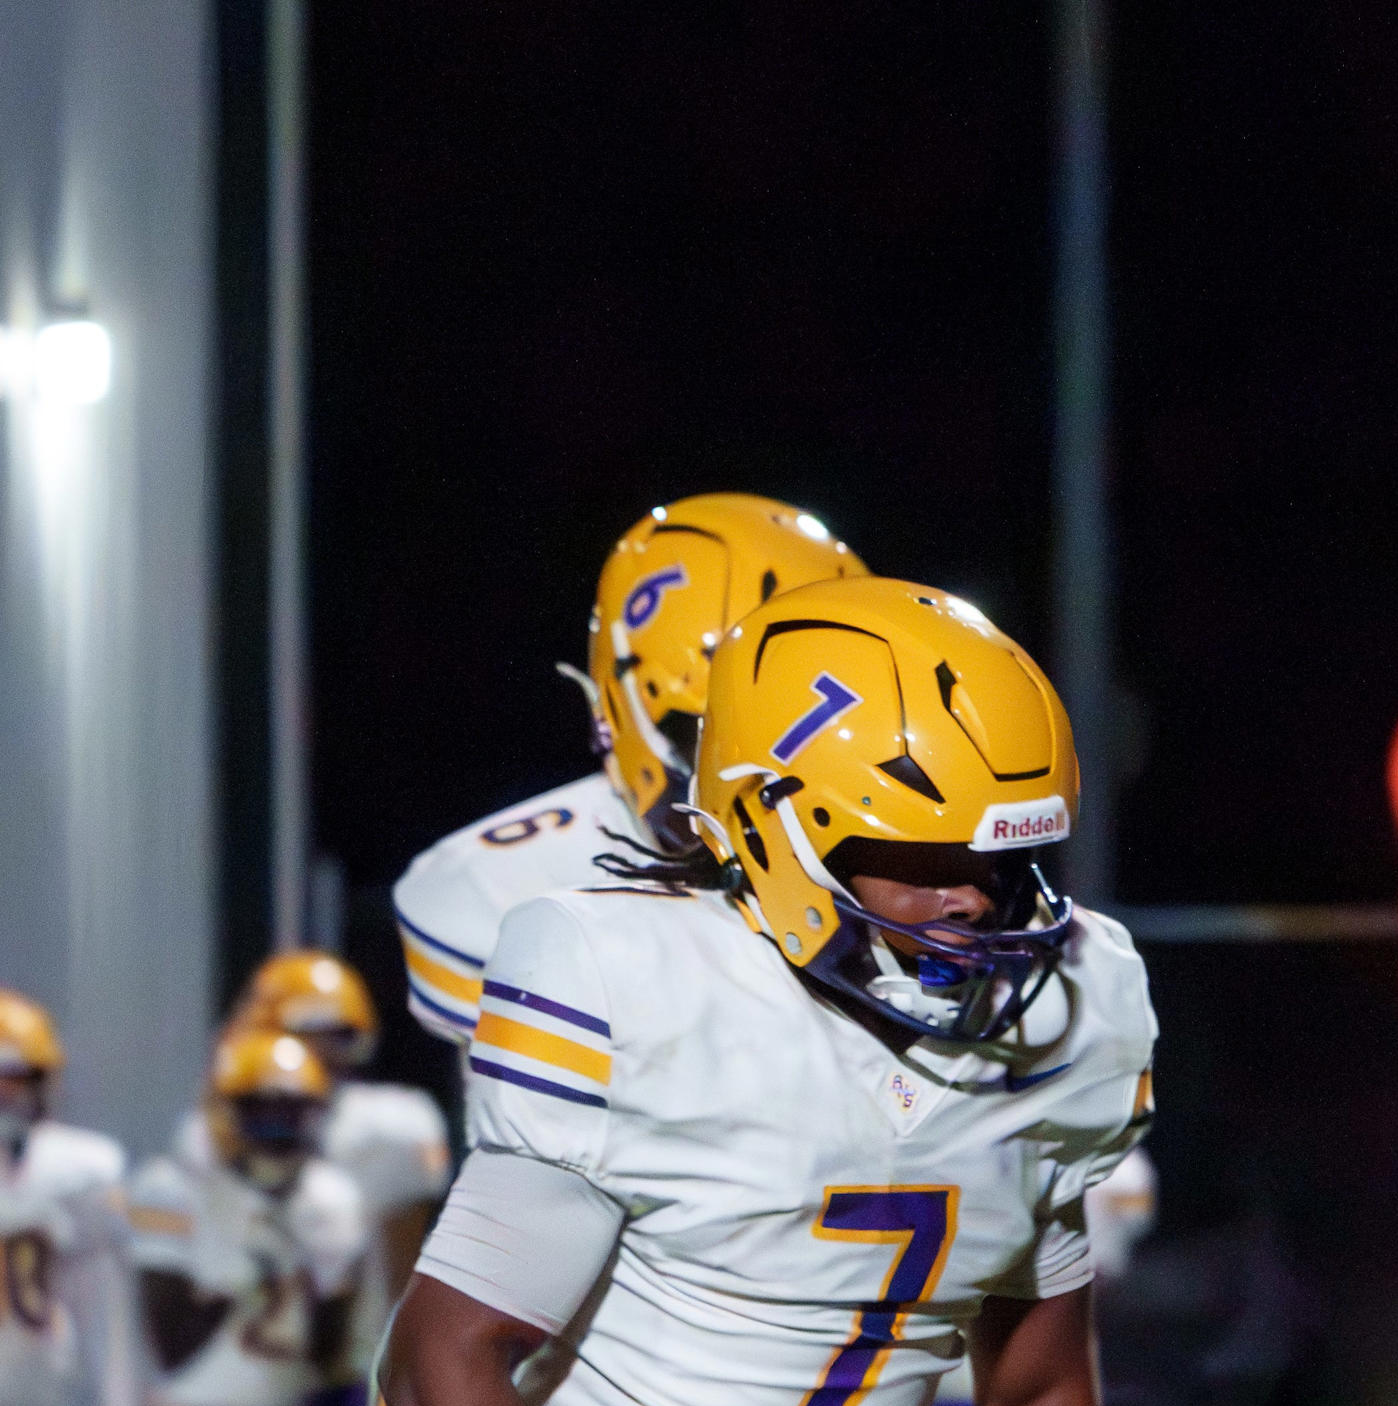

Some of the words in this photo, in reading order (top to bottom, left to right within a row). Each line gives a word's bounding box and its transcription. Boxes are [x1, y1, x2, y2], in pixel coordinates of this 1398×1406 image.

[622, 563, 690, 632] 6
[769, 670, 864, 766] 7
[478, 807, 575, 848] 6
